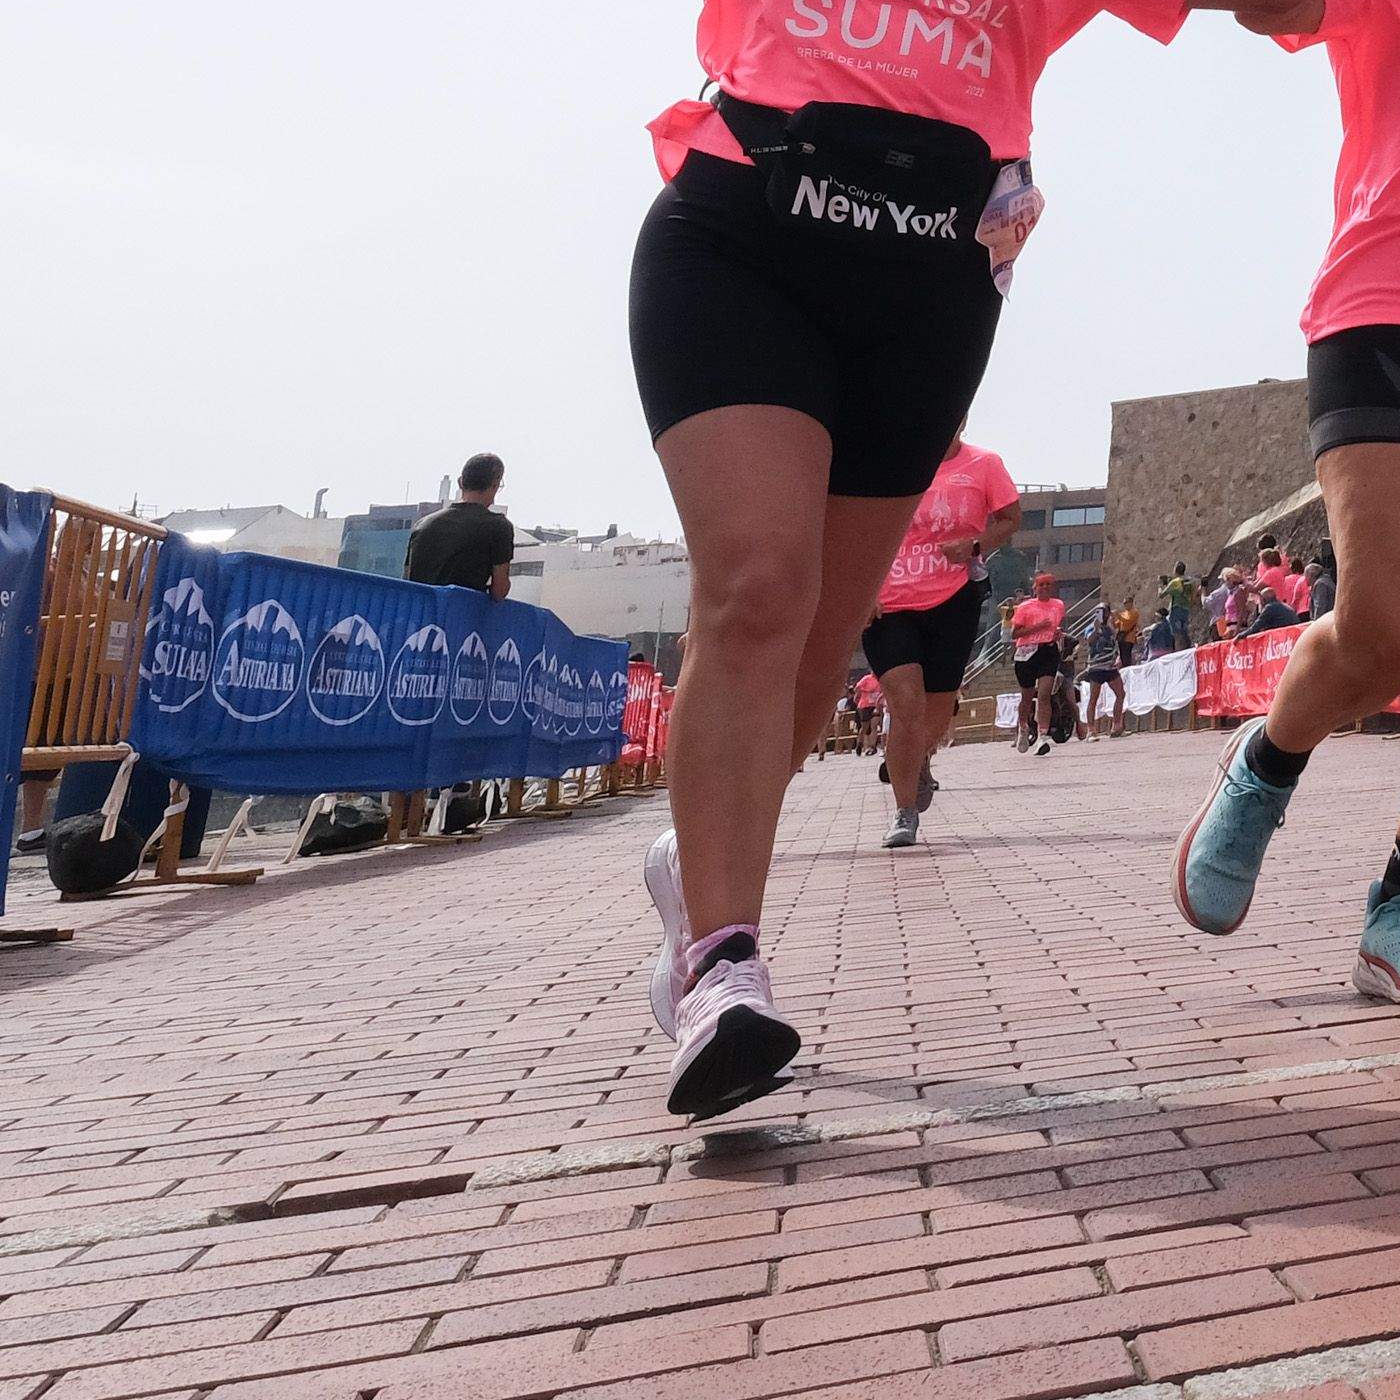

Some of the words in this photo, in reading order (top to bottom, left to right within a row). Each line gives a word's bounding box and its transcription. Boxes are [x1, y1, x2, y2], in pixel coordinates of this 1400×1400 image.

[838, 55, 853, 66] DE
[857, 58, 872, 70] LA
[876, 62, 919, 80] MUJER
[791, 175, 880, 231] New
[886, 201, 959, 240] York
[848, 184, 870, 200] City
[312, 652, 377, 697] ASTURIANA
